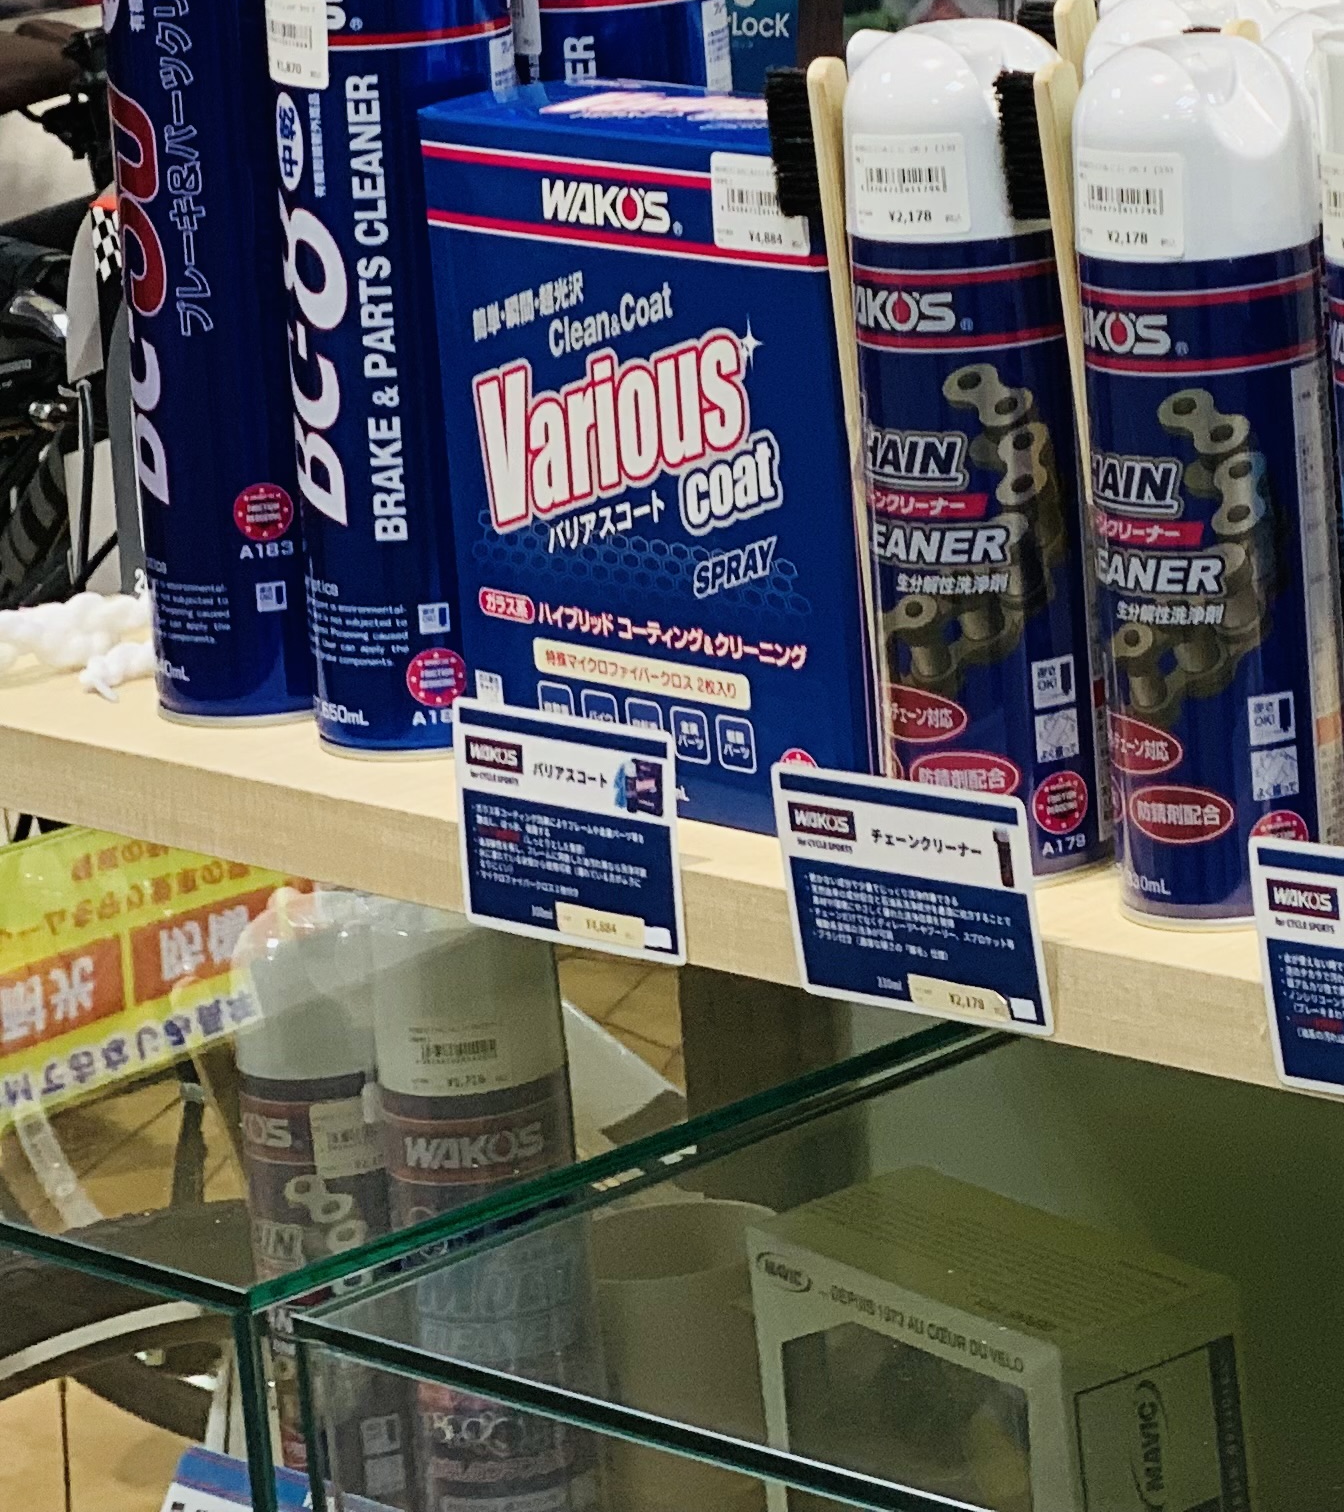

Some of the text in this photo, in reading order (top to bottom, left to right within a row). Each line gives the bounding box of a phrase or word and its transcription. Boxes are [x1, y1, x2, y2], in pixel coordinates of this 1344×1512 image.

[888, 208, 932, 225] ¥2,178
[1107, 229, 1149, 246] ¥2,178
[346, 73, 408, 542] BRAKE & PARTS CLEANER
[474, 328, 747, 532] Various
[547, 490, 665, 553] バリアスコート
[239, 539, 294, 558] A183
[693, 536, 778, 598] SPRAY
[896, 572, 1008, 594] 生分解性洗浄剤
[1117, 601, 1224, 625] 生分解性洗浄剤
[538, 603, 807, 669] ハイブリッド コーティング&クリーニング
[533, 762, 608, 787] バリアスコート
[1137, 801, 1222, 831] 防錆剤配合
[870, 828, 982, 856] チェーンクリーナー
